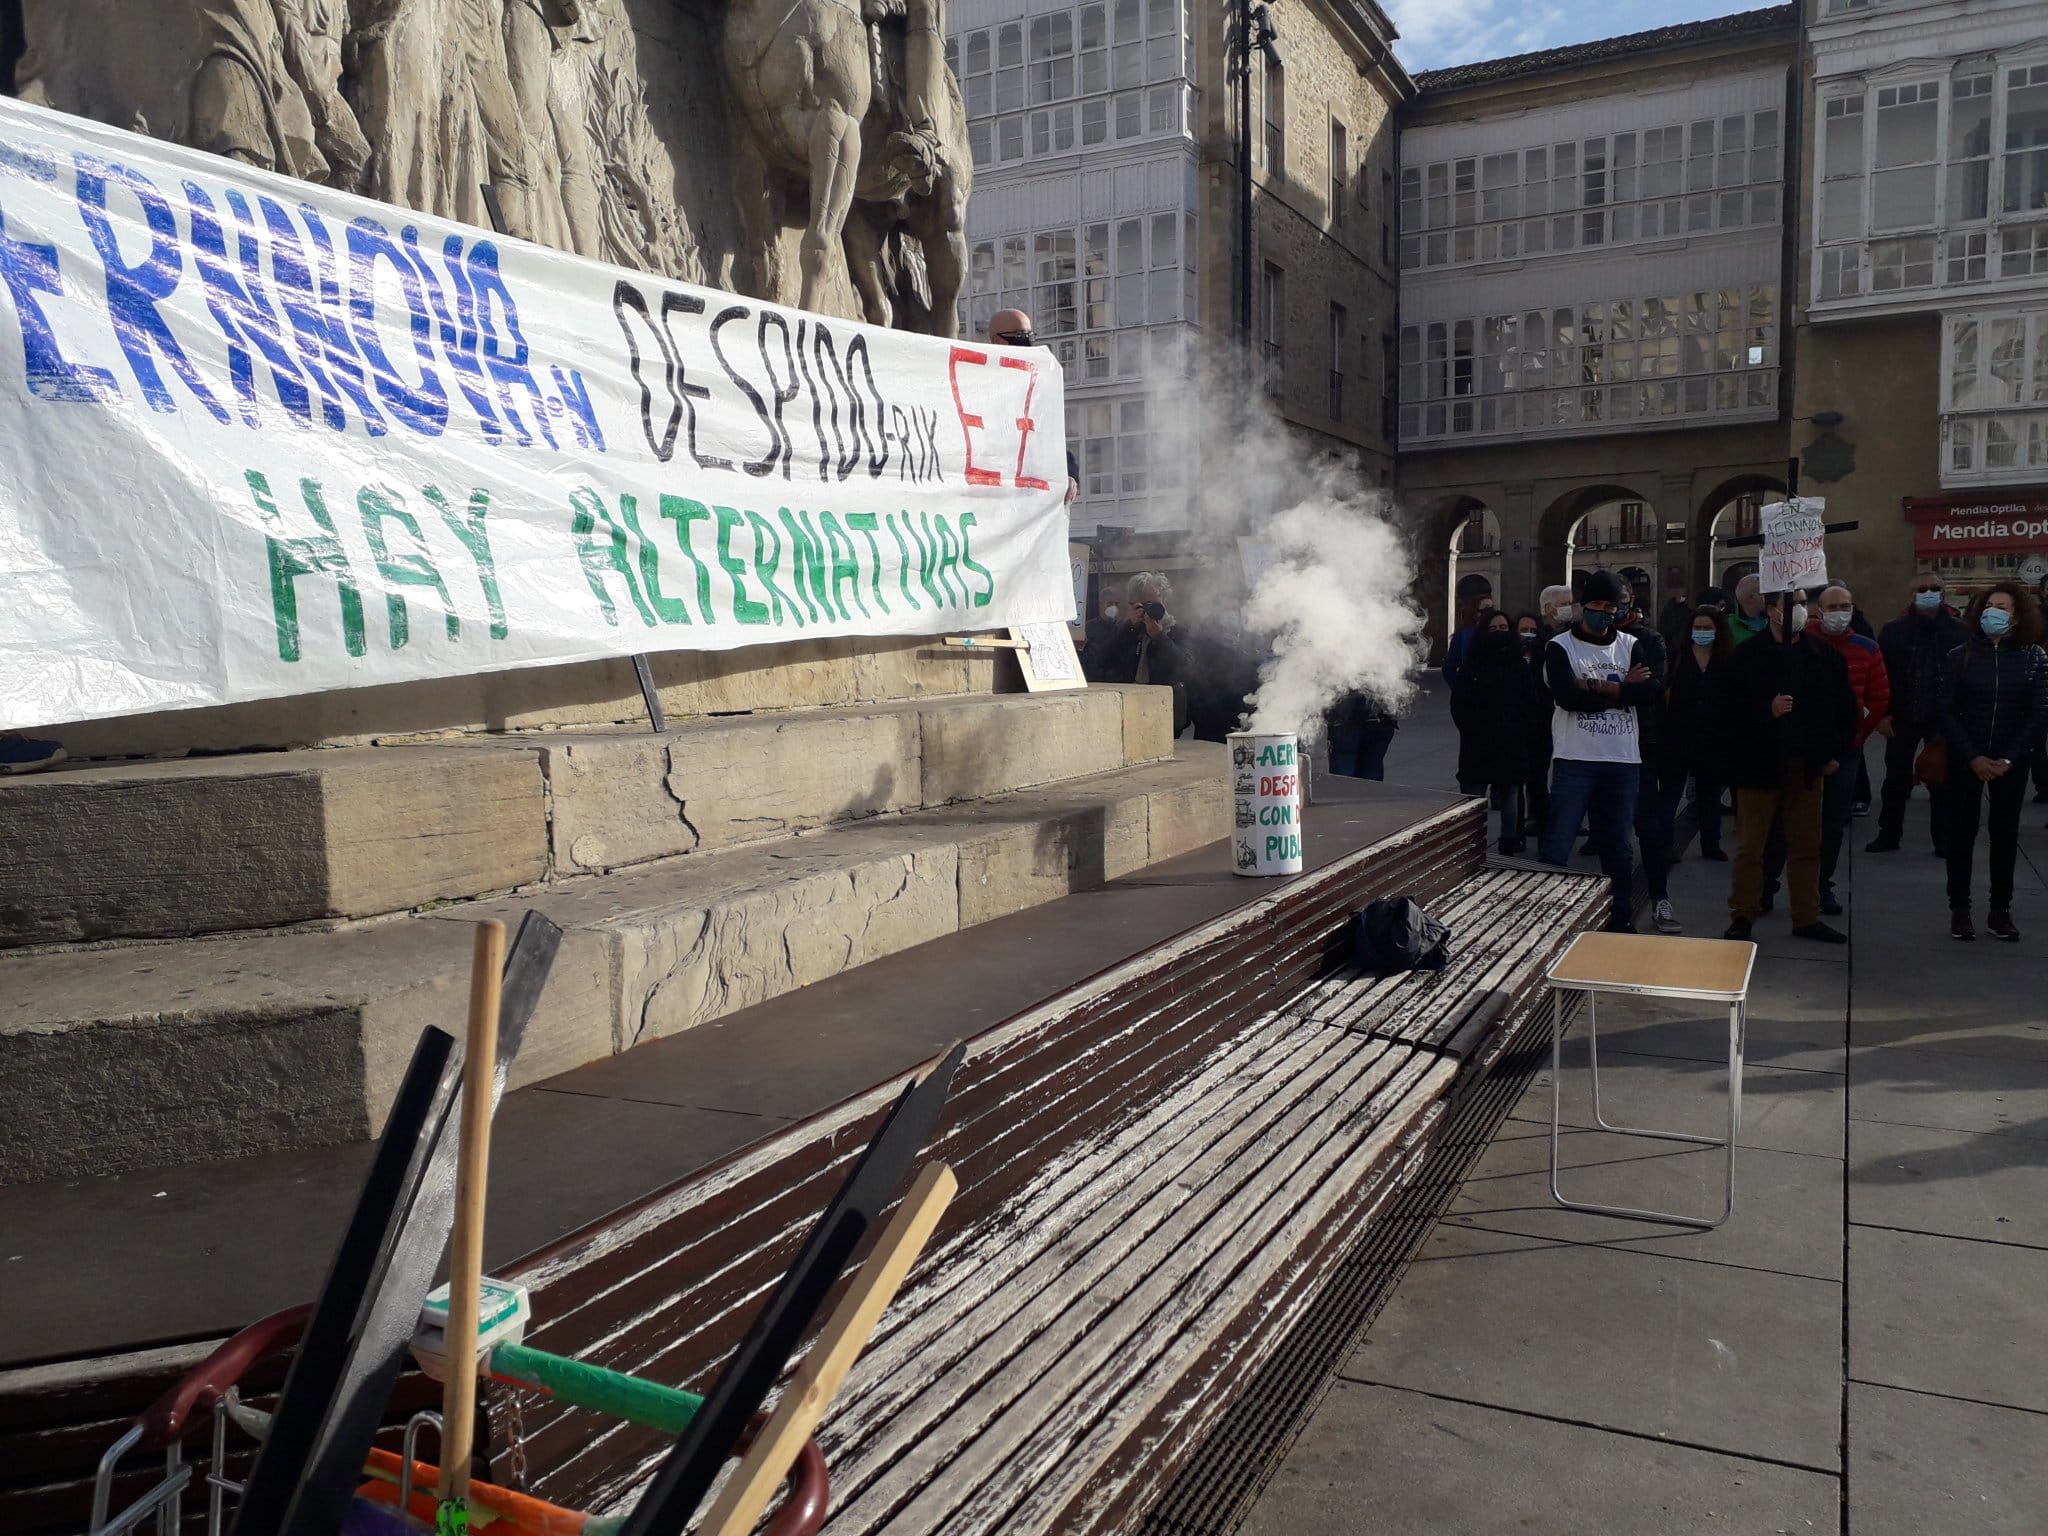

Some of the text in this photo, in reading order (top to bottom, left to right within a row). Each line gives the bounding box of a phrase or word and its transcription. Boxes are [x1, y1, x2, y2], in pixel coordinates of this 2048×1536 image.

[948, 345, 1049, 490] EZ
[1951, 506, 1989, 515] Mendia
[1990, 504, 2026, 514] Optika
[1933, 519, 2048, 540] Mendia Opt
[243, 467, 994, 663] HAY ALTERNATIVAS
[1772, 556, 1820, 584] NADIE
[1260, 774, 1299, 797] DESP
[1259, 805, 1291, 825] CON
